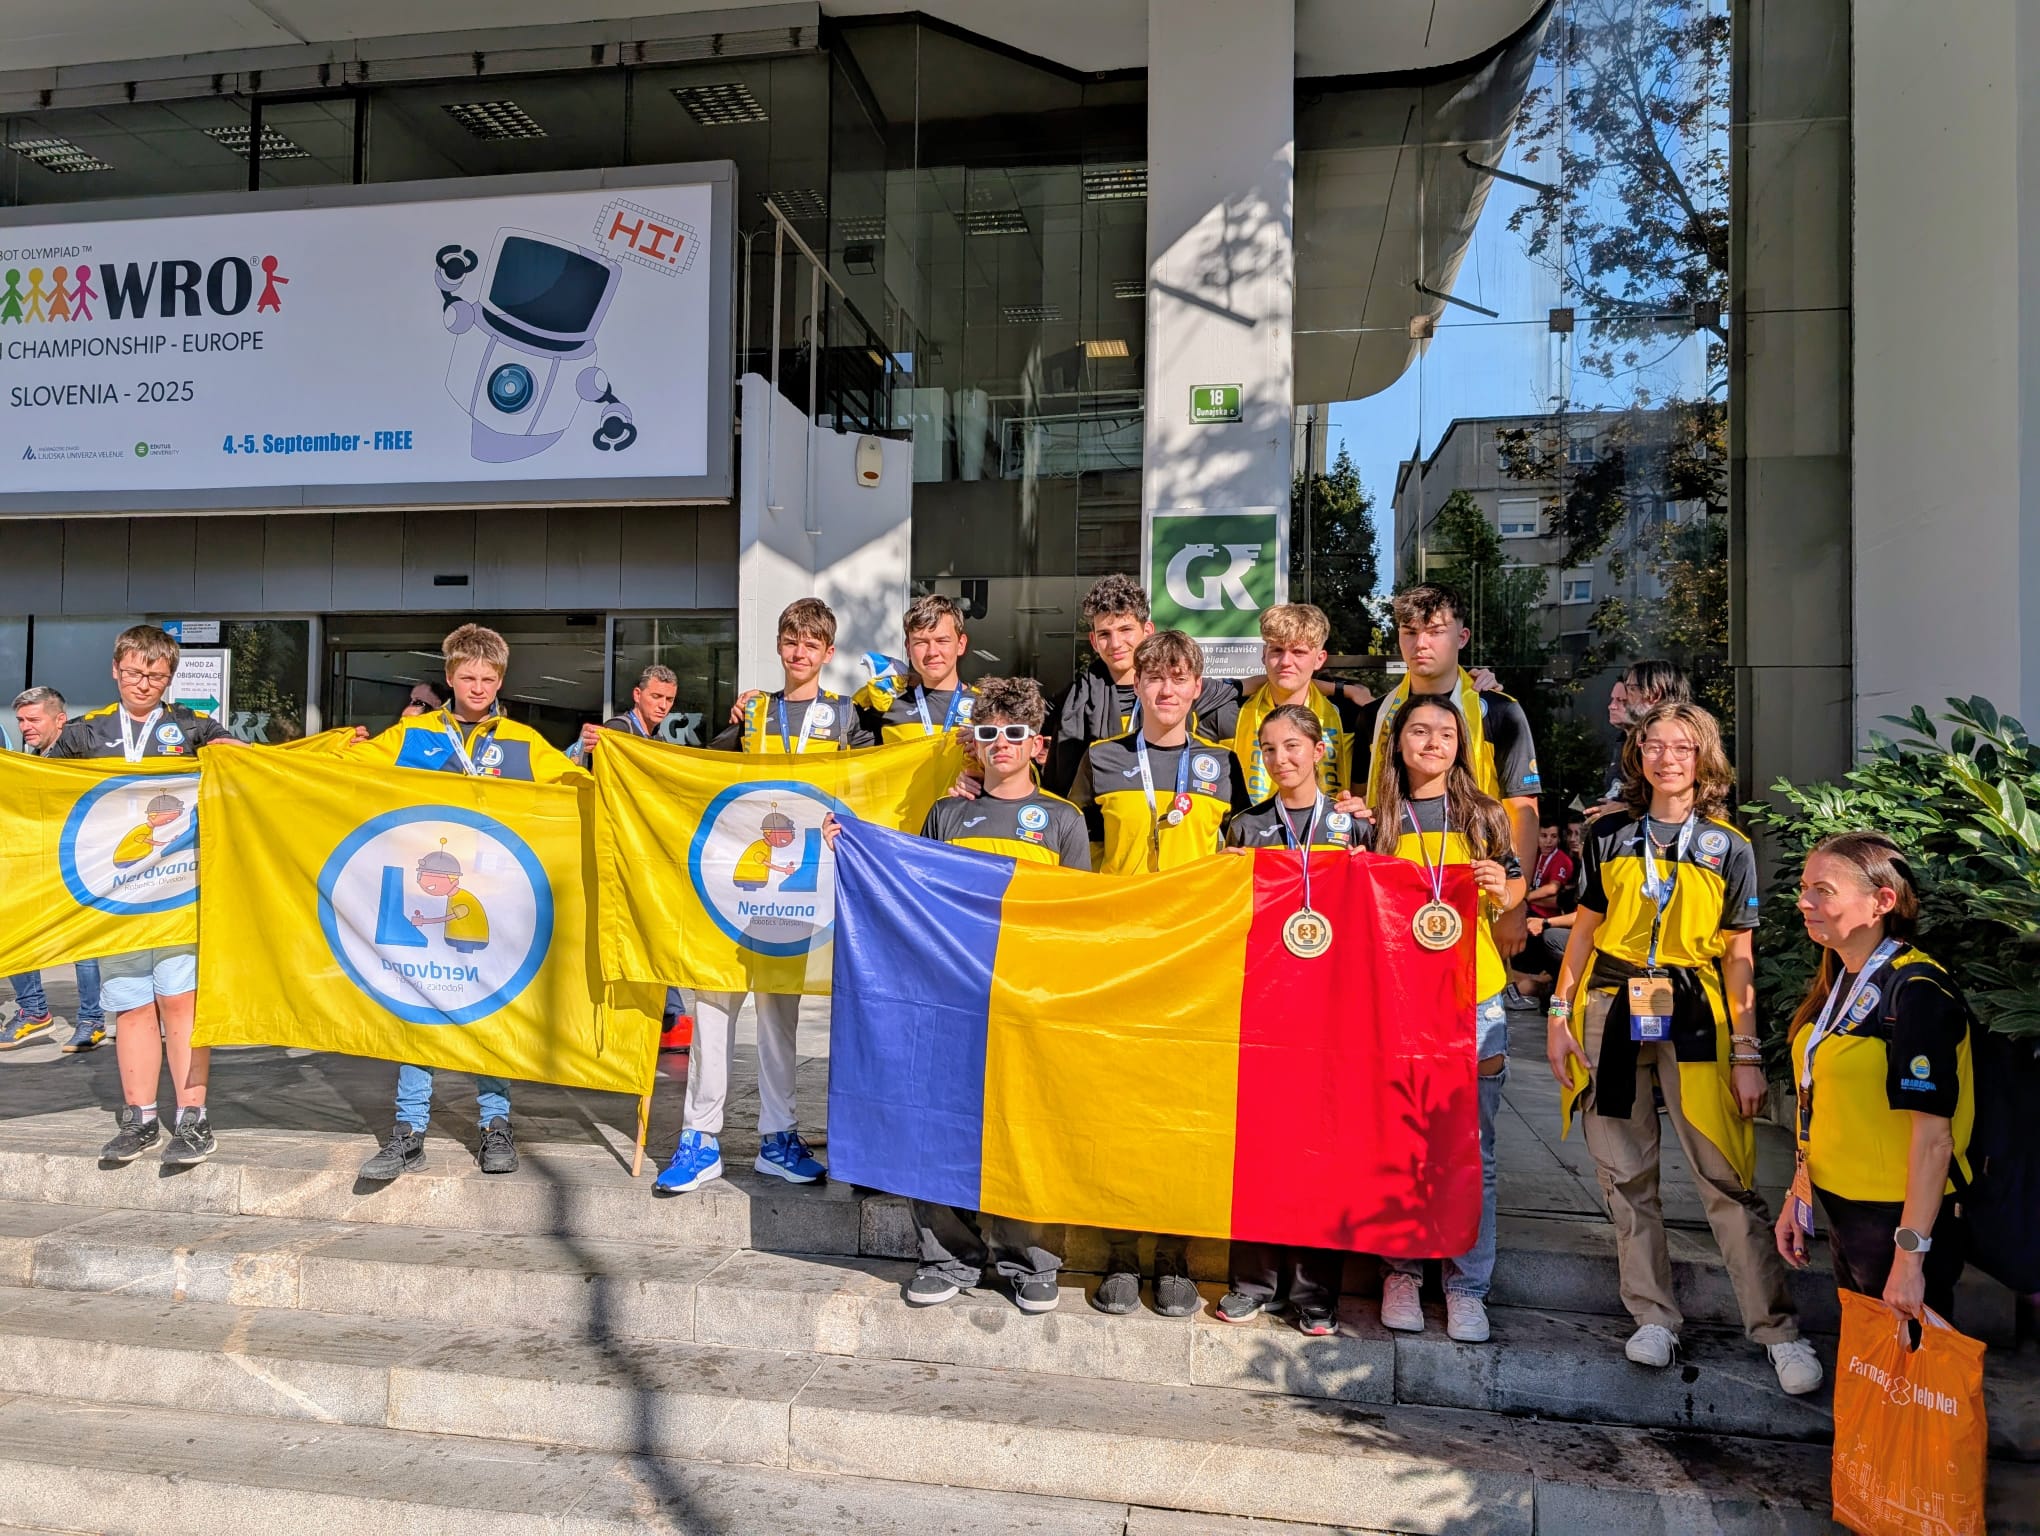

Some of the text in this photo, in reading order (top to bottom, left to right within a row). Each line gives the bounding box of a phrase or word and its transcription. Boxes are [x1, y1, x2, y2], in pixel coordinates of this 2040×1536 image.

[608, 211, 685, 265] HI!
[22, 246, 80, 260] OLYMPIAD
[8, 335, 166, 359] CHAMPIONSHIP
[183, 331, 264, 353] EUROPE
[11, 384, 119, 407] SLOVENIA
[137, 381, 194, 403] 2025
[1210, 389, 1224, 406] 18
[1196, 407, 1228, 418] Dunajska
[263, 433, 360, 455] September
[374, 431, 413, 450] FREE
[1205, 665, 1267, 675] Convention Centr
[112, 860, 199, 889] Nerdvana
[738, 901, 816, 917] Nerdvana
[1936, 1391, 1958, 1417] Net
